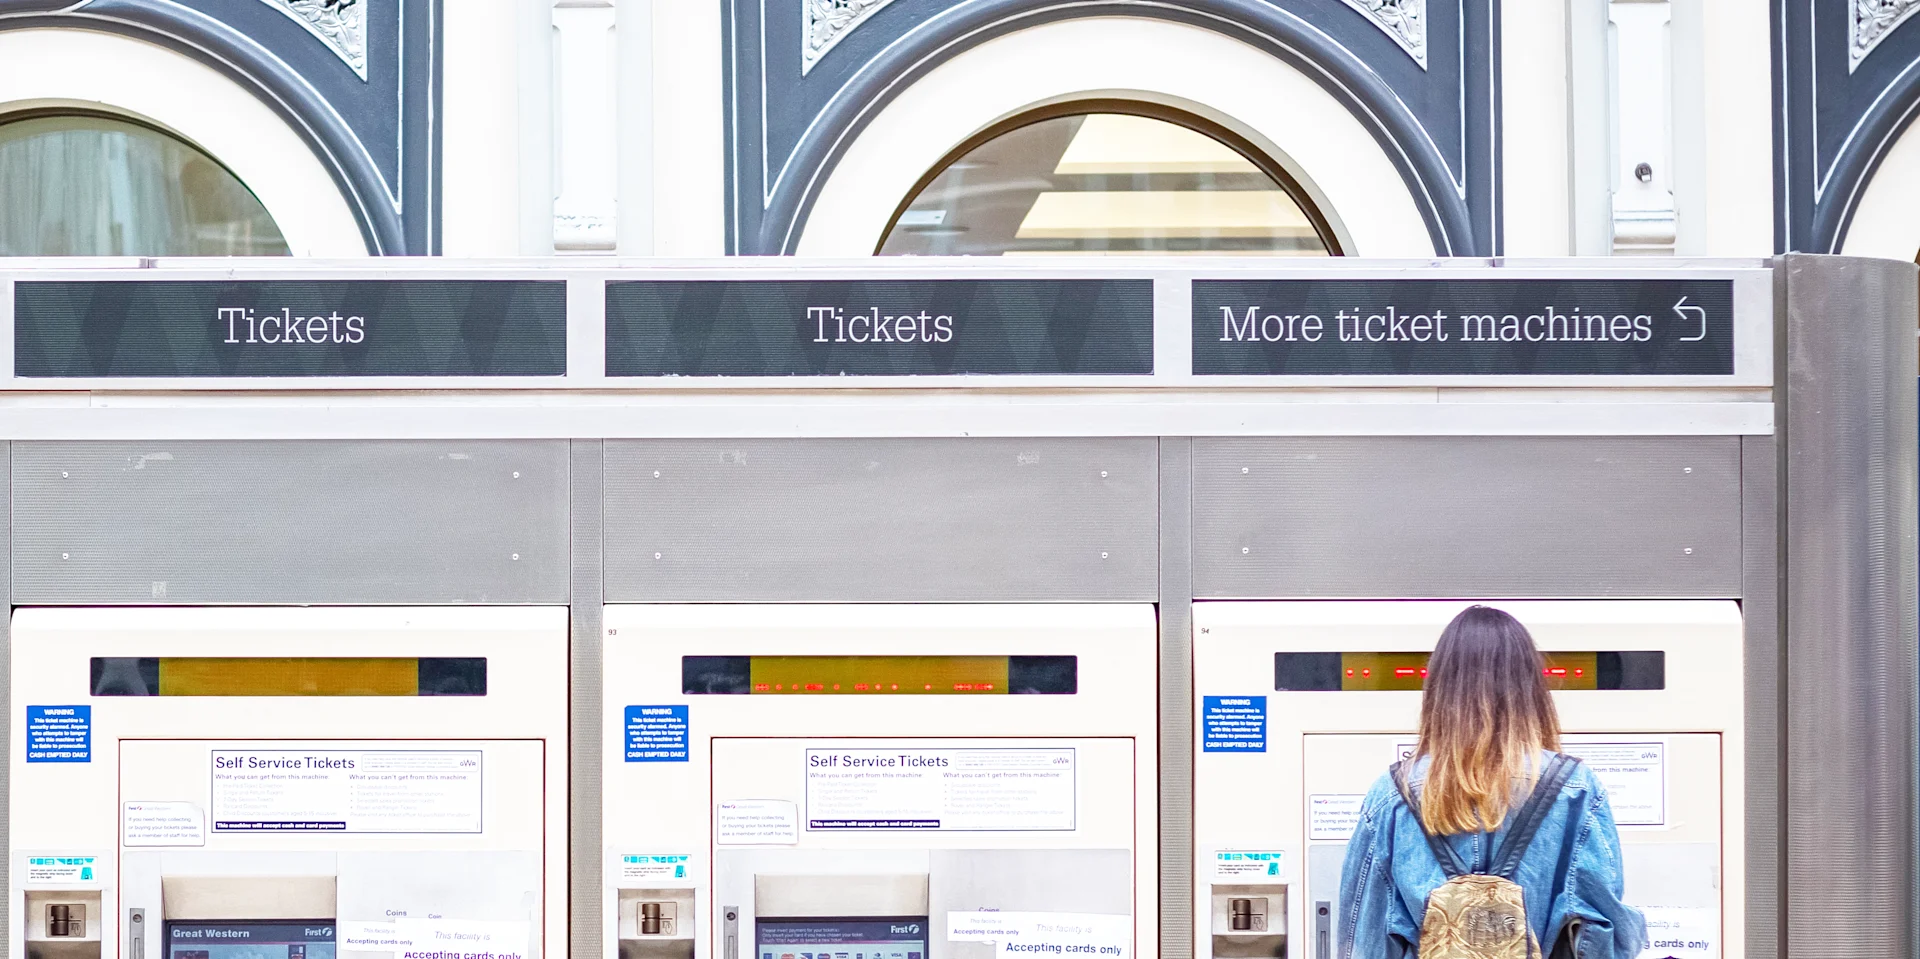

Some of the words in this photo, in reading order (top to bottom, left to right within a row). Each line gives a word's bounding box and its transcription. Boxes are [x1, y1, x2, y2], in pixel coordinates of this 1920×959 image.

[218, 307, 364, 344] Tickets
[807, 307, 952, 342] Tickets
[1219, 306, 1323, 342] More
[1335, 306, 1448, 342] ticket
[1460, 306, 1652, 342] machines
[216, 756, 244, 768] Self
[248, 756, 301, 768] Service
[304, 757, 355, 768] Tickets
[810, 755, 838, 767] Self
[842, 755, 895, 767] Service
[898, 755, 948, 767] Tickets
[173, 929, 202, 937] Great
[205, 929, 249, 938] Western
[1036, 924, 1053, 932] This
[1056, 924, 1082, 935] facility
[435, 931, 452, 940] This
[454, 932, 481, 942] facility
[1006, 942, 1062, 954] Accepting
[1065, 944, 1096, 953] cards
[1100, 946, 1122, 956] only
[1654, 939, 1684, 948] cards
[1688, 940, 1709, 950] only
[404, 951, 460, 959] Accepting
